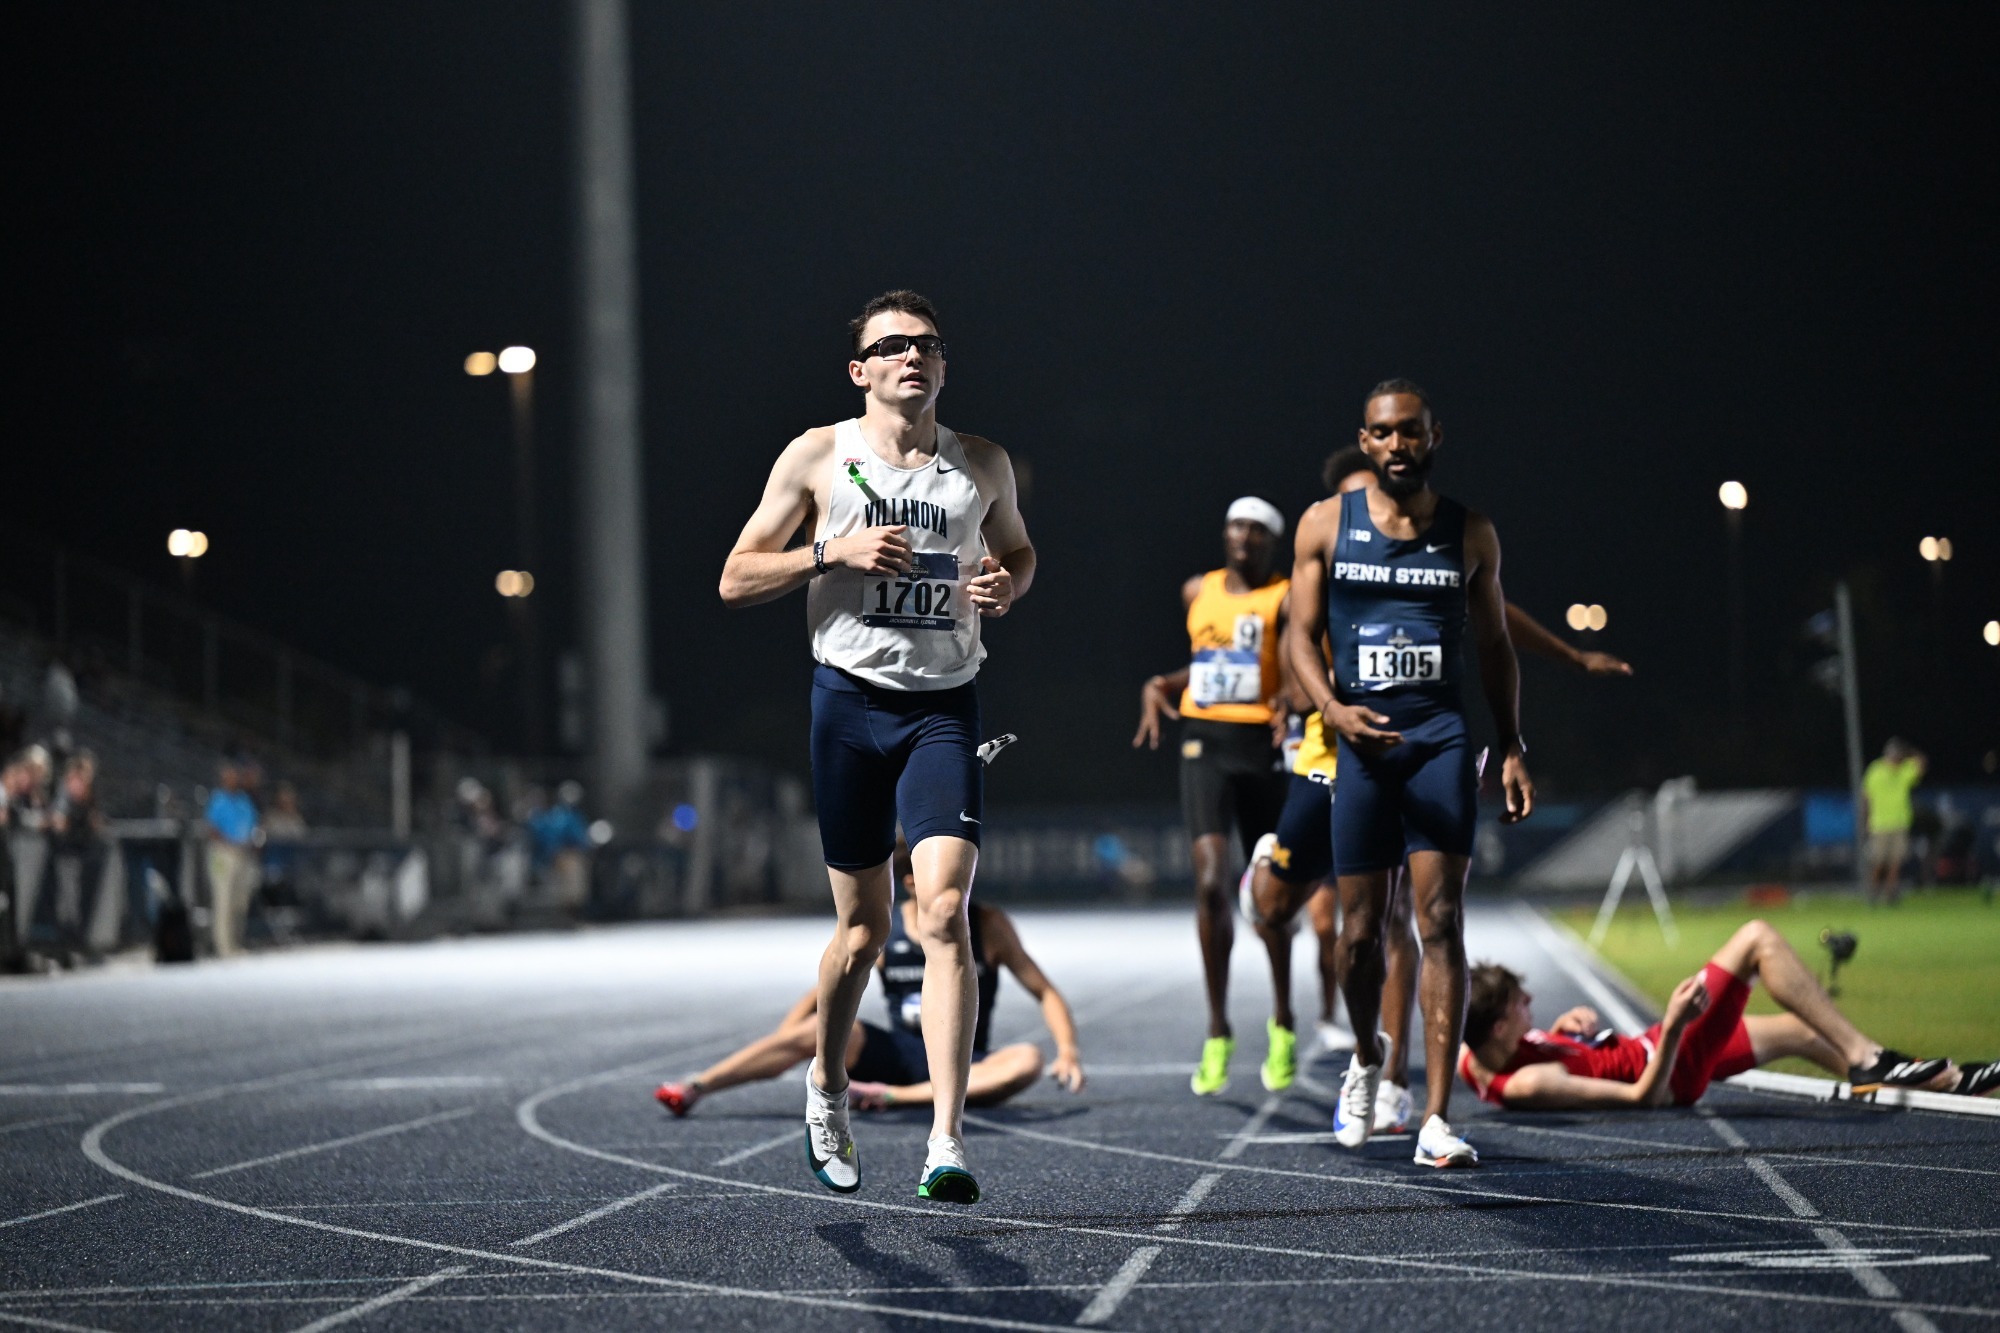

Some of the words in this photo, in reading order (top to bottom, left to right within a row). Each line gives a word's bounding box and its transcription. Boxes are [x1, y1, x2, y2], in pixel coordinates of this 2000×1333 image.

[865, 498, 948, 539] VILLANOVA
[1334, 562, 1391, 583] PENN
[1395, 567, 1460, 587] STATE
[875, 581, 950, 616] 1702
[1369, 651, 1433, 677] 1305
